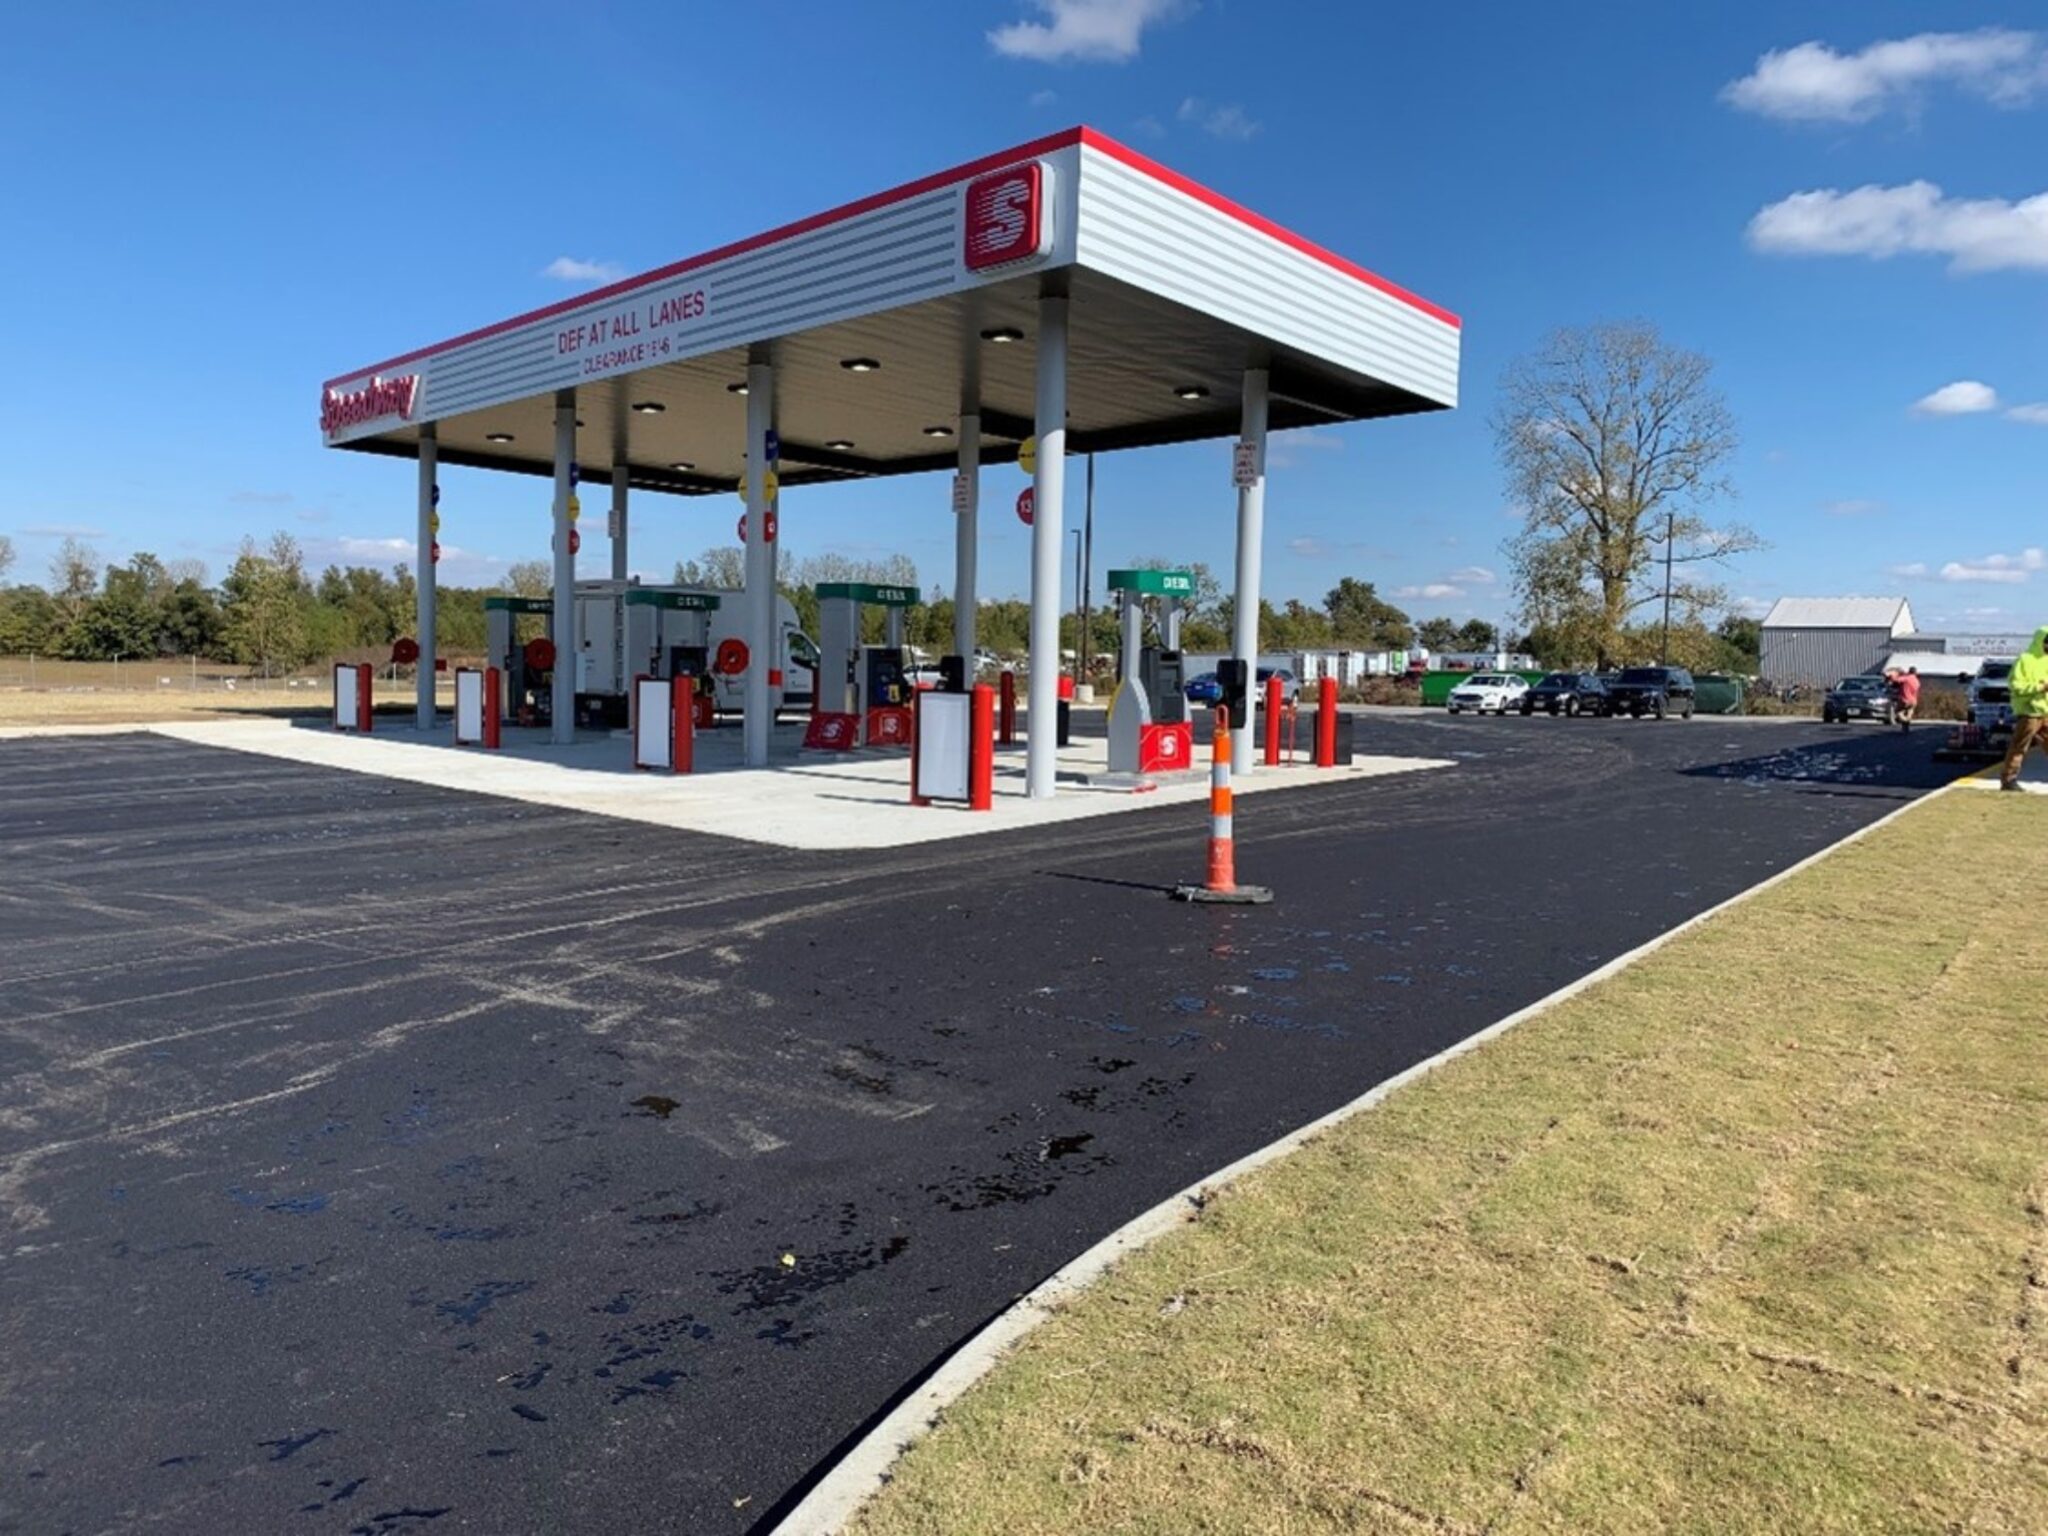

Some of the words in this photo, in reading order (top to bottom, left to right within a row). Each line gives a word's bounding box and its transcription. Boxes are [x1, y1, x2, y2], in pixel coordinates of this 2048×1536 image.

[558, 325, 586, 355] DEF
[587, 319, 608, 348] AT
[611, 310, 641, 340] ALL
[649, 289, 706, 330] LANES
[584, 343, 645, 375] CLEARANCE
